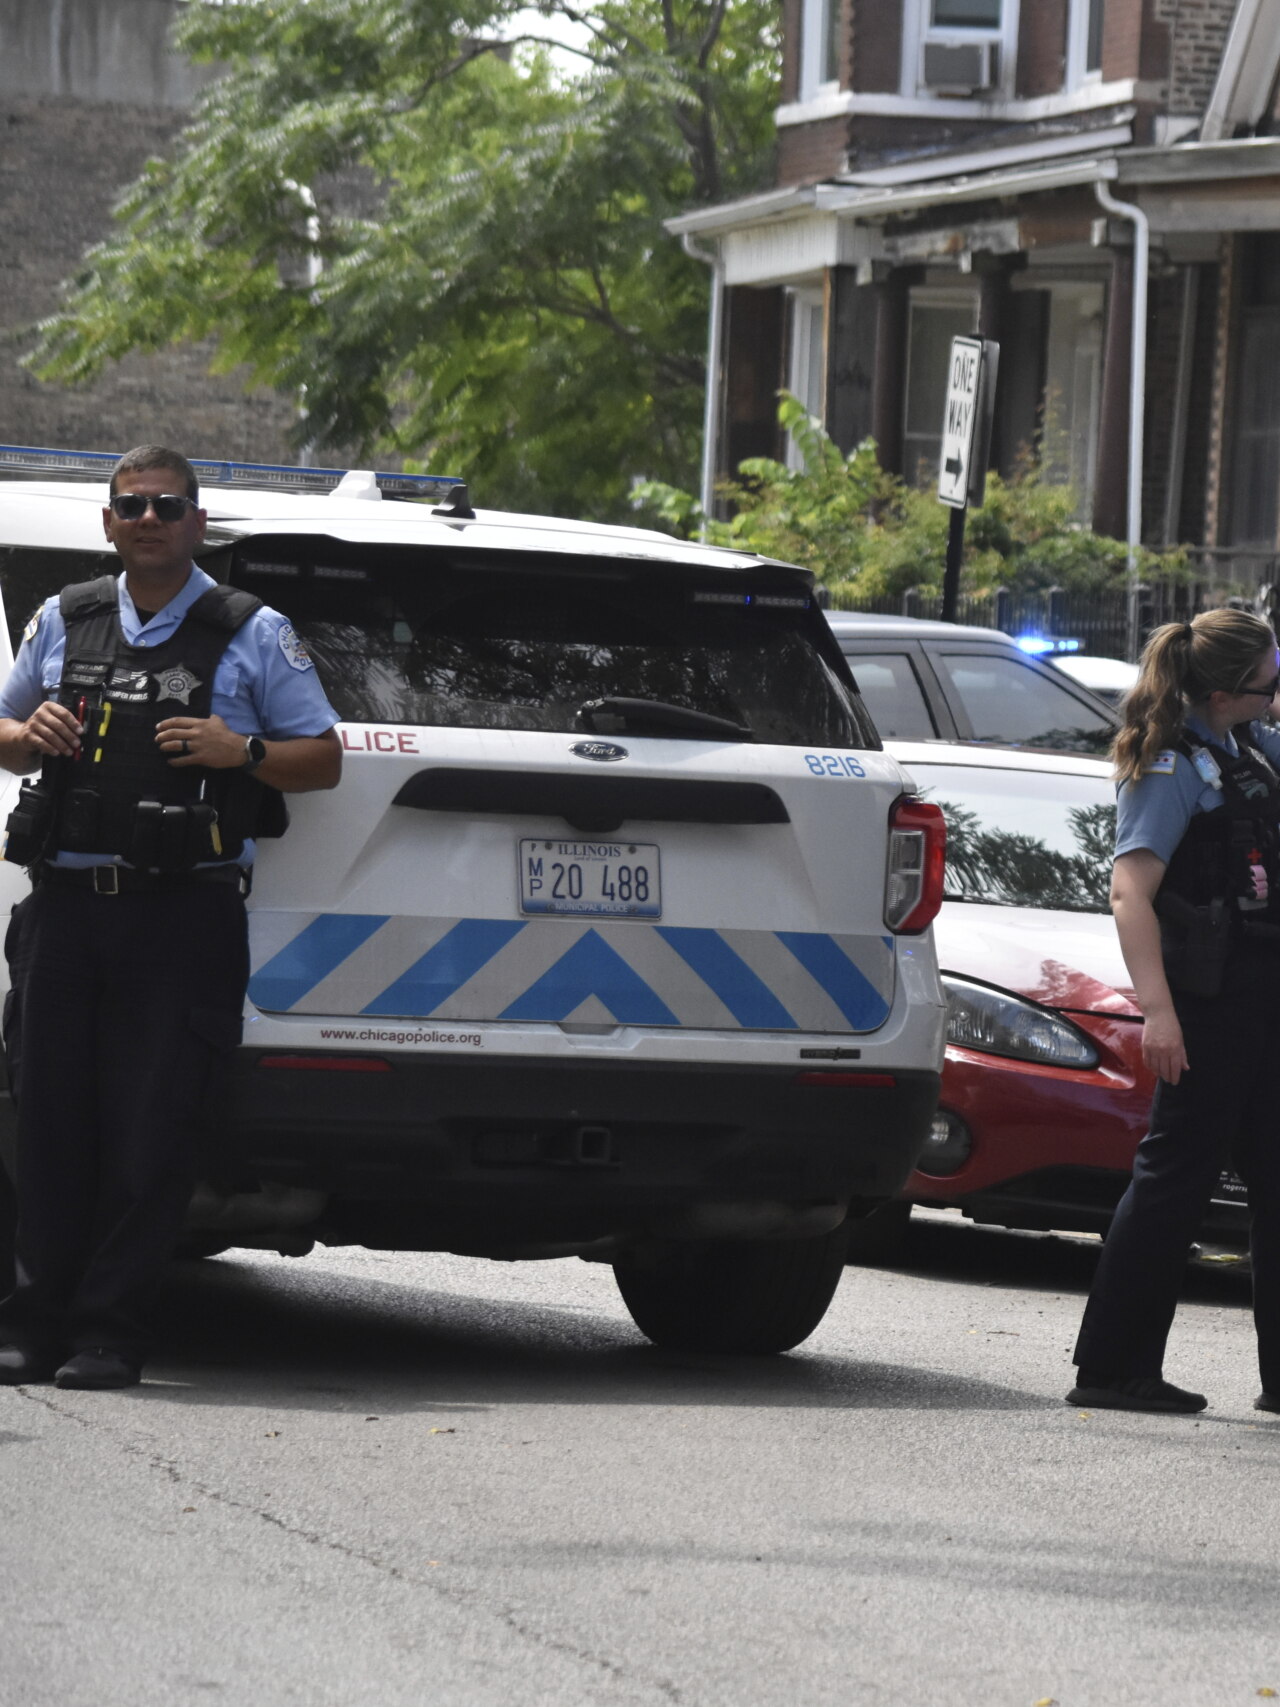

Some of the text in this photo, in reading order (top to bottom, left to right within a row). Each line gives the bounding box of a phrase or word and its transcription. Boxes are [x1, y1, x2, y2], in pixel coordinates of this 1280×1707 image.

[953, 355, 976, 393] ONE
[949, 399, 972, 437] WAY
[342, 729, 420, 754] LICE
[584, 743, 616, 756] Ford
[804, 754, 866, 778] 8216
[558, 843, 622, 857] ILLINOIS
[551, 862, 583, 900] 20
[602, 864, 650, 902] 488
[601, 904, 629, 913] POLICE
[320, 1028, 482, 1046] www.chicagopolice.org
